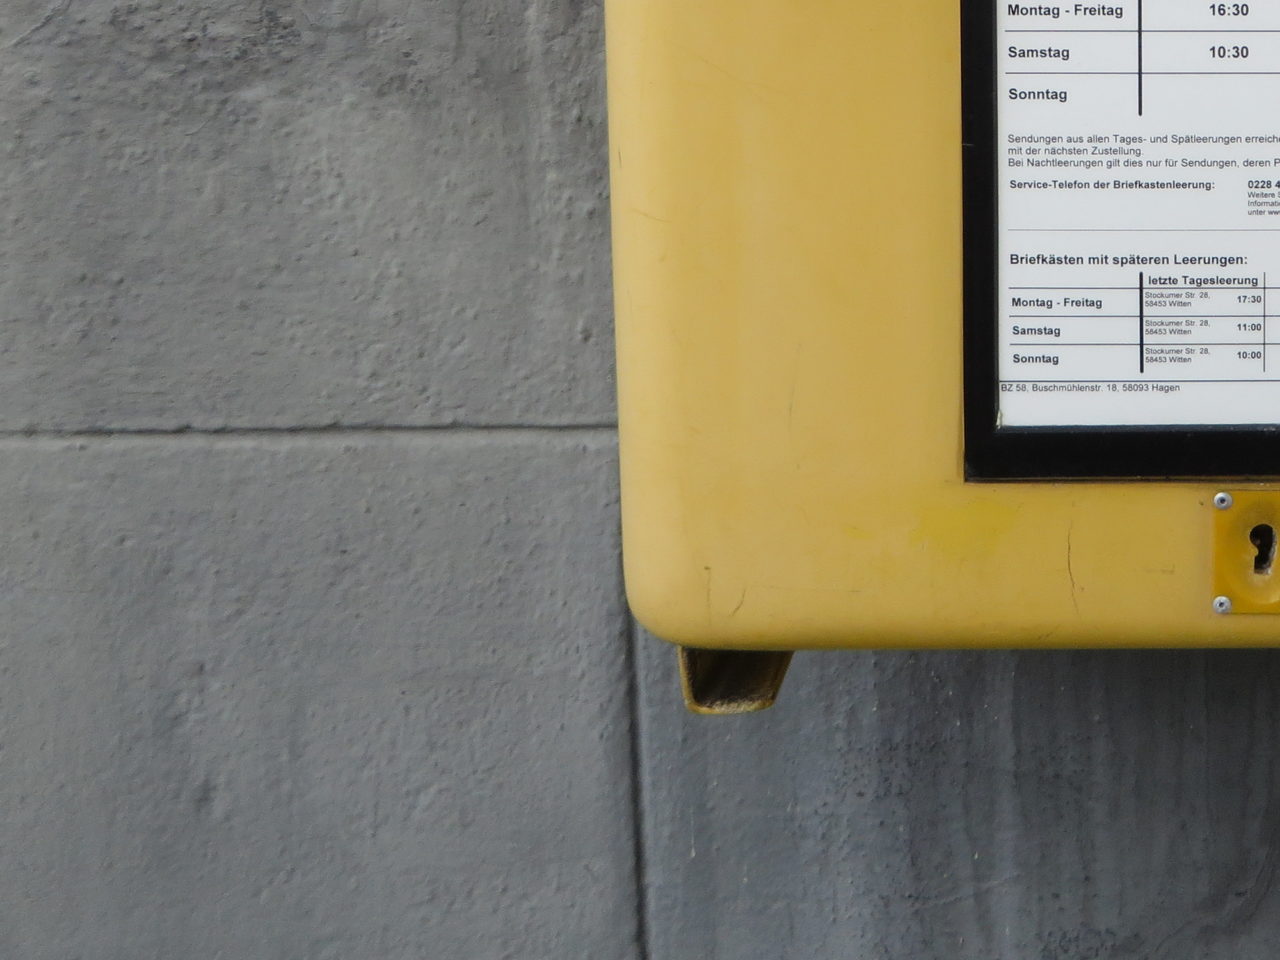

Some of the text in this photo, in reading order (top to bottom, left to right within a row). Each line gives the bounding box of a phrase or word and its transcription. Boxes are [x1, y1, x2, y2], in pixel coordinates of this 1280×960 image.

[1008, 4, 1060, 18] Montag
[1074, 4, 1123, 18] Freitag
[1209, 4, 1249, 16] 16:30
[1008, 46, 1070, 60] Samstag
[1209, 46, 1249, 58] 10:30
[1009, 88, 1067, 102] Sonntag
[1008, 135, 1063, 145] Sendungen
[1066, 136, 1083, 144] aus
[1087, 135, 1109, 144] allen
[1113, 135, 1146, 145] Tages-
[1150, 135, 1168, 144] und
[1171, 135, 1242, 145] Spätleerungen
[1008, 147, 1022, 155] mit
[1026, 147, 1041, 155] der
[1044, 147, 1088, 155] nächsten
[1008, 159, 1024, 167] Bei
[1027, 159, 1103, 169] Nachtleerungen
[1106, 159, 1120, 169] gilt
[1123, 159, 1143, 167] dies
[1165, 159, 1177, 167] für
[1181, 159, 1240, 169] Sendungen,
[1243, 158, 1270, 167] deren
[1010, 180, 1215, 191] Service-Telefon der Briefkastenleerung:
[1248, 181, 1272, 189] 0228
[1010, 254, 1248, 267] Briefkästen mit späteren Leerungen:
[1149, 276, 1258, 287] letzte Tagesleerung
[1012, 298, 1053, 309] Montag
[1064, 298, 1102, 309] Freitag
[1012, 326, 1060, 337] Samstag
[1013, 354, 1059, 365] Sonntag
[1237, 351, 1262, 359] 10:00
[1001, 384, 1013, 392] BZ
[1123, 384, 1149, 392] 58093
[1152, 384, 1180, 393] Hagen
